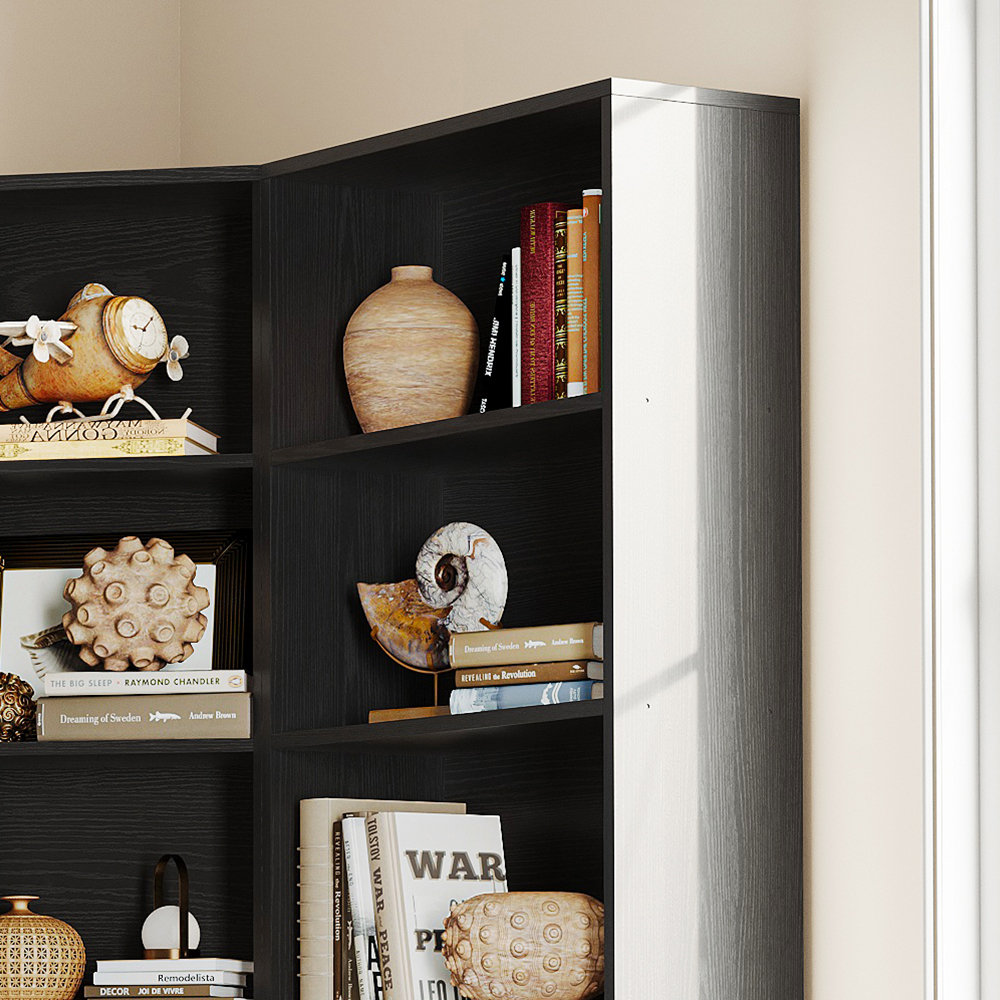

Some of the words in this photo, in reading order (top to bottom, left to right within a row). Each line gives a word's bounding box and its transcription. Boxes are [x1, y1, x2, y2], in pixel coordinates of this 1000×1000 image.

[484, 337, 498, 377] HENDRIX
[50, 680, 67, 688] THE
[69, 679, 85, 688] BIG
[88, 679, 113, 687] SLEEP
[124, 678, 171, 687] RAYMOND
[173, 677, 220, 686] CHANDLER
[501, 669, 536, 680] Revolution
[60, 713, 99, 725] Dreaming
[100, 713, 109, 723] of
[109, 712, 142, 723] Sweden
[188, 711, 214, 720] Andrew
[215, 711, 237, 720] Brown
[366, 818, 381, 862] TOLSTOY
[405, 849, 506, 882] WAR
[373, 866, 385, 914] WAR
[334, 890, 342, 941] Revolution
[379, 929, 394, 991] PEACE
[100, 987, 130, 997] DECOR
[138, 987, 150, 995] JOI
[151, 987, 161, 995] DE
[162, 987, 184, 995] VIVRE
[157, 973, 215, 983] Remodelista
